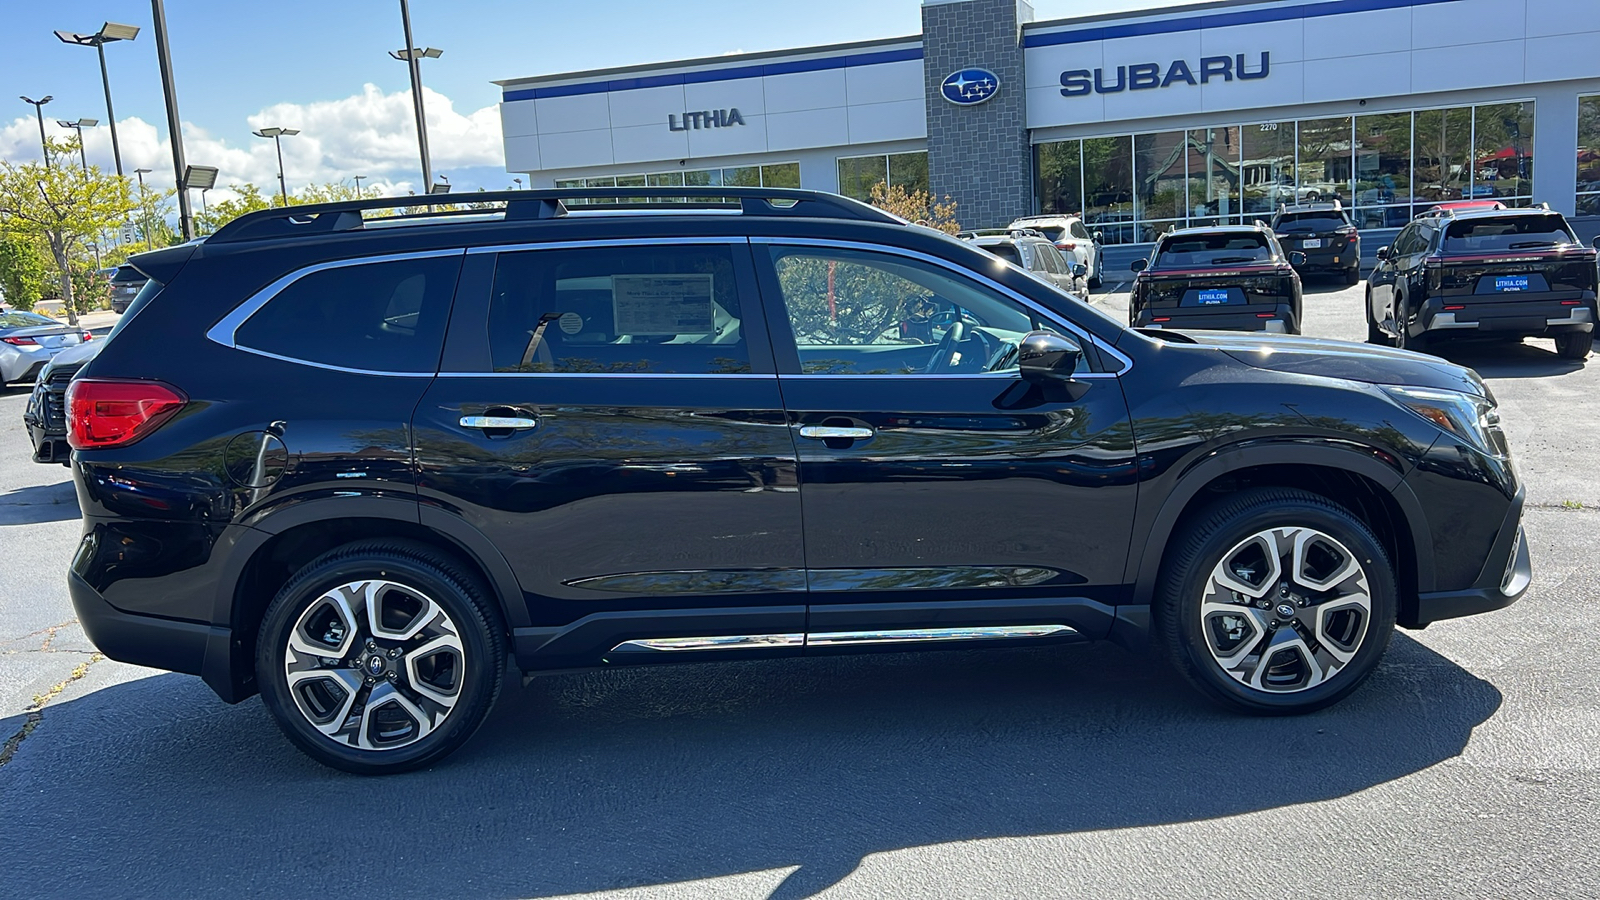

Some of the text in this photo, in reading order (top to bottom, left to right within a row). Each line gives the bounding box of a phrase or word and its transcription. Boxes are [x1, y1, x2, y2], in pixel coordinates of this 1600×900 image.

[1060, 51, 1270, 97] SUBARU
[668, 108, 746, 131] LITHIA
[1260, 123, 1278, 131] 2270
[125, 234, 131, 243] 5
[1496, 279, 1528, 287] LITHIA.COM
